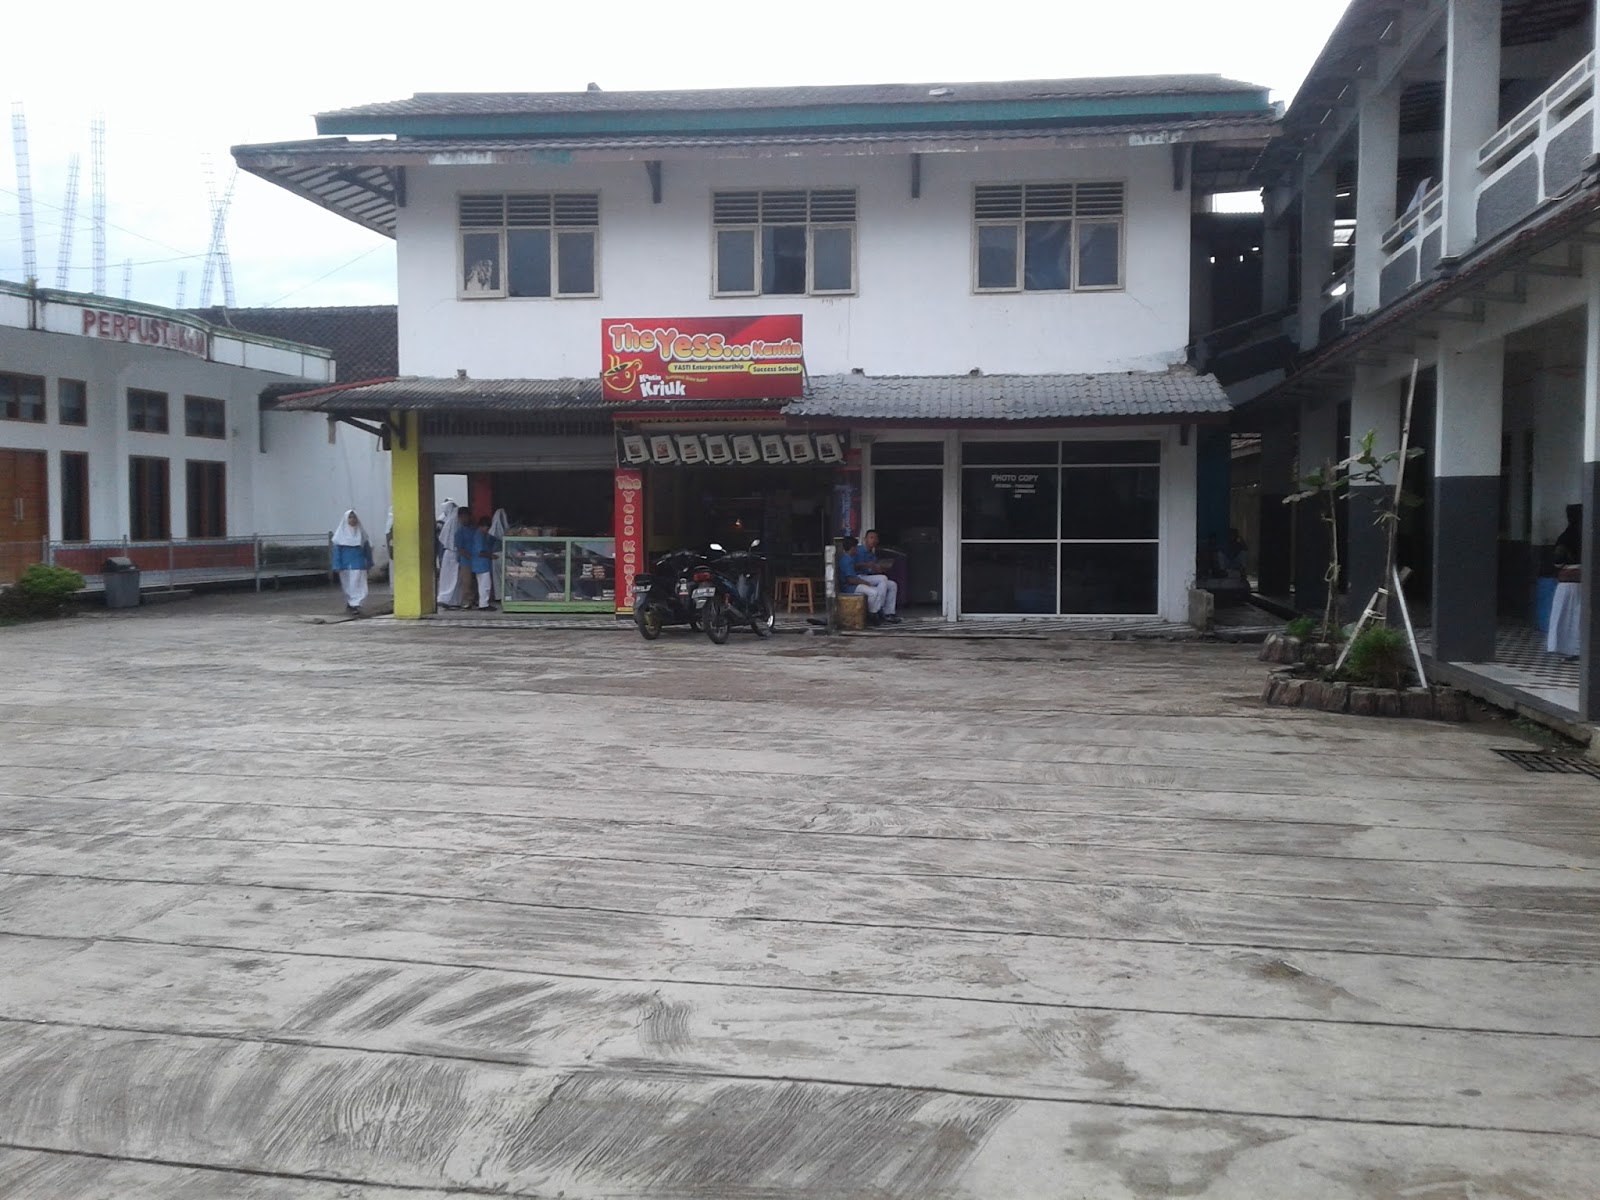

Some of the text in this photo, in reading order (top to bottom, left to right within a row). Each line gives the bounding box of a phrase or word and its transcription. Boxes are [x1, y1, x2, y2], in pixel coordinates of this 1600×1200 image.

[609, 323, 656, 353] The
[751, 338, 802, 359] Kantin
[640, 379, 686, 398] Kriuk
[616, 475, 642, 490] The
[991, 474, 1039, 482] PHOTO COPY
